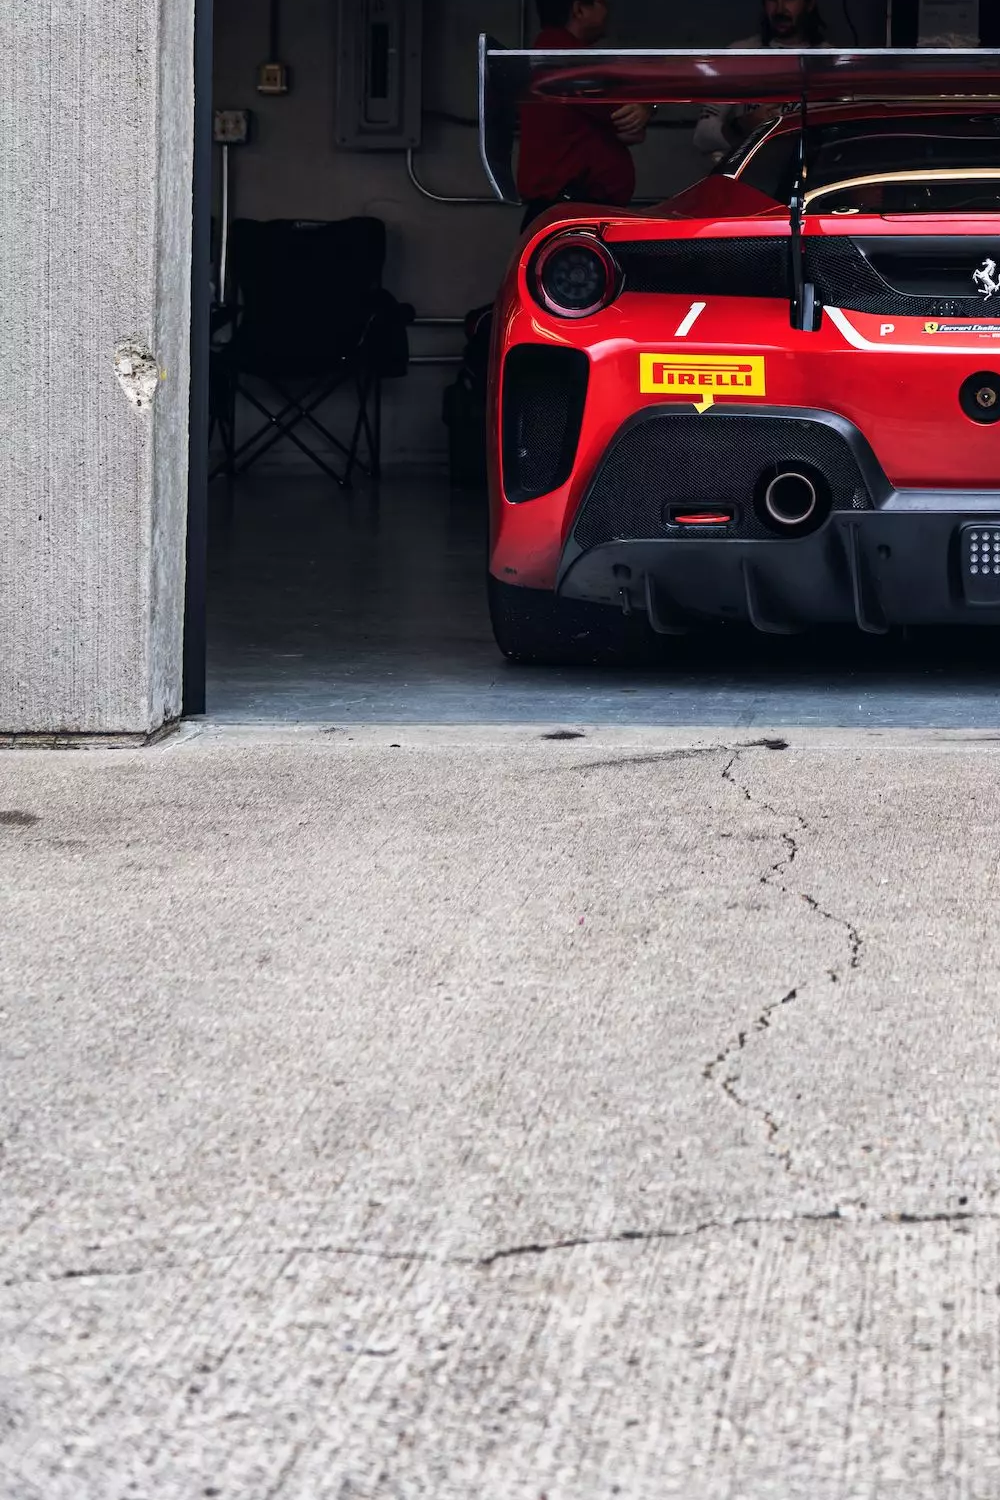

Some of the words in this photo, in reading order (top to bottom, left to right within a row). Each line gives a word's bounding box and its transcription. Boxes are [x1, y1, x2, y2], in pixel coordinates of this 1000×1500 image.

[880, 323, 895, 336] P
[940, 324, 973, 332] Ferrari
[652, 362, 753, 387] PIRELLI
